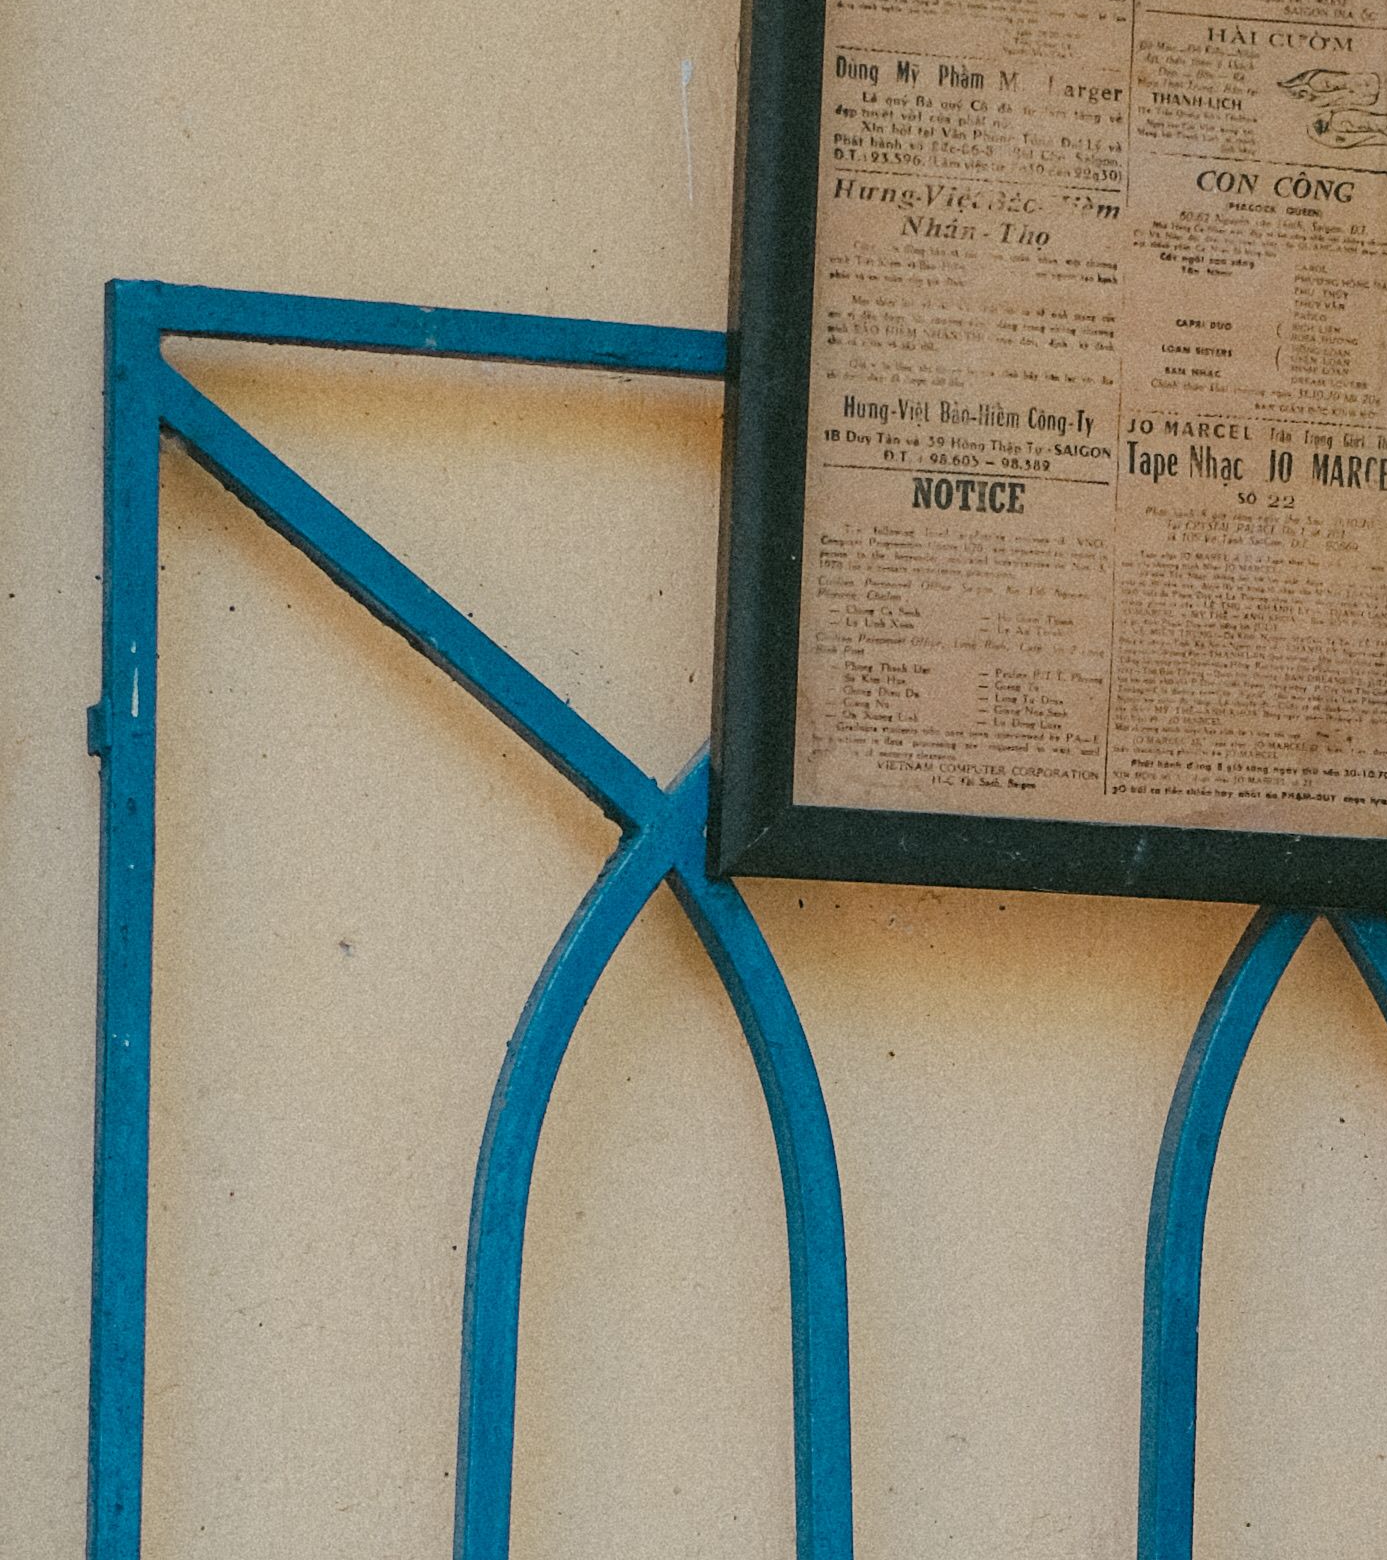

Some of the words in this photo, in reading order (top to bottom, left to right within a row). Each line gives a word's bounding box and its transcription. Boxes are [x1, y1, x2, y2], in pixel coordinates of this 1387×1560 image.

[1197, 171, 1259, 192] CON
[1274, 172, 1355, 203] CÔNG
[1127, 418, 1154, 434] JO
[1164, 420, 1253, 440] MARCEL
[1126, 440, 1178, 484] Tape
[1189, 444, 1244, 488] Nhạc
[1268, 448, 1293, 484] JO
[912, 477, 1026, 513] NOTICE
[1266, 494, 1295, 509] 22
